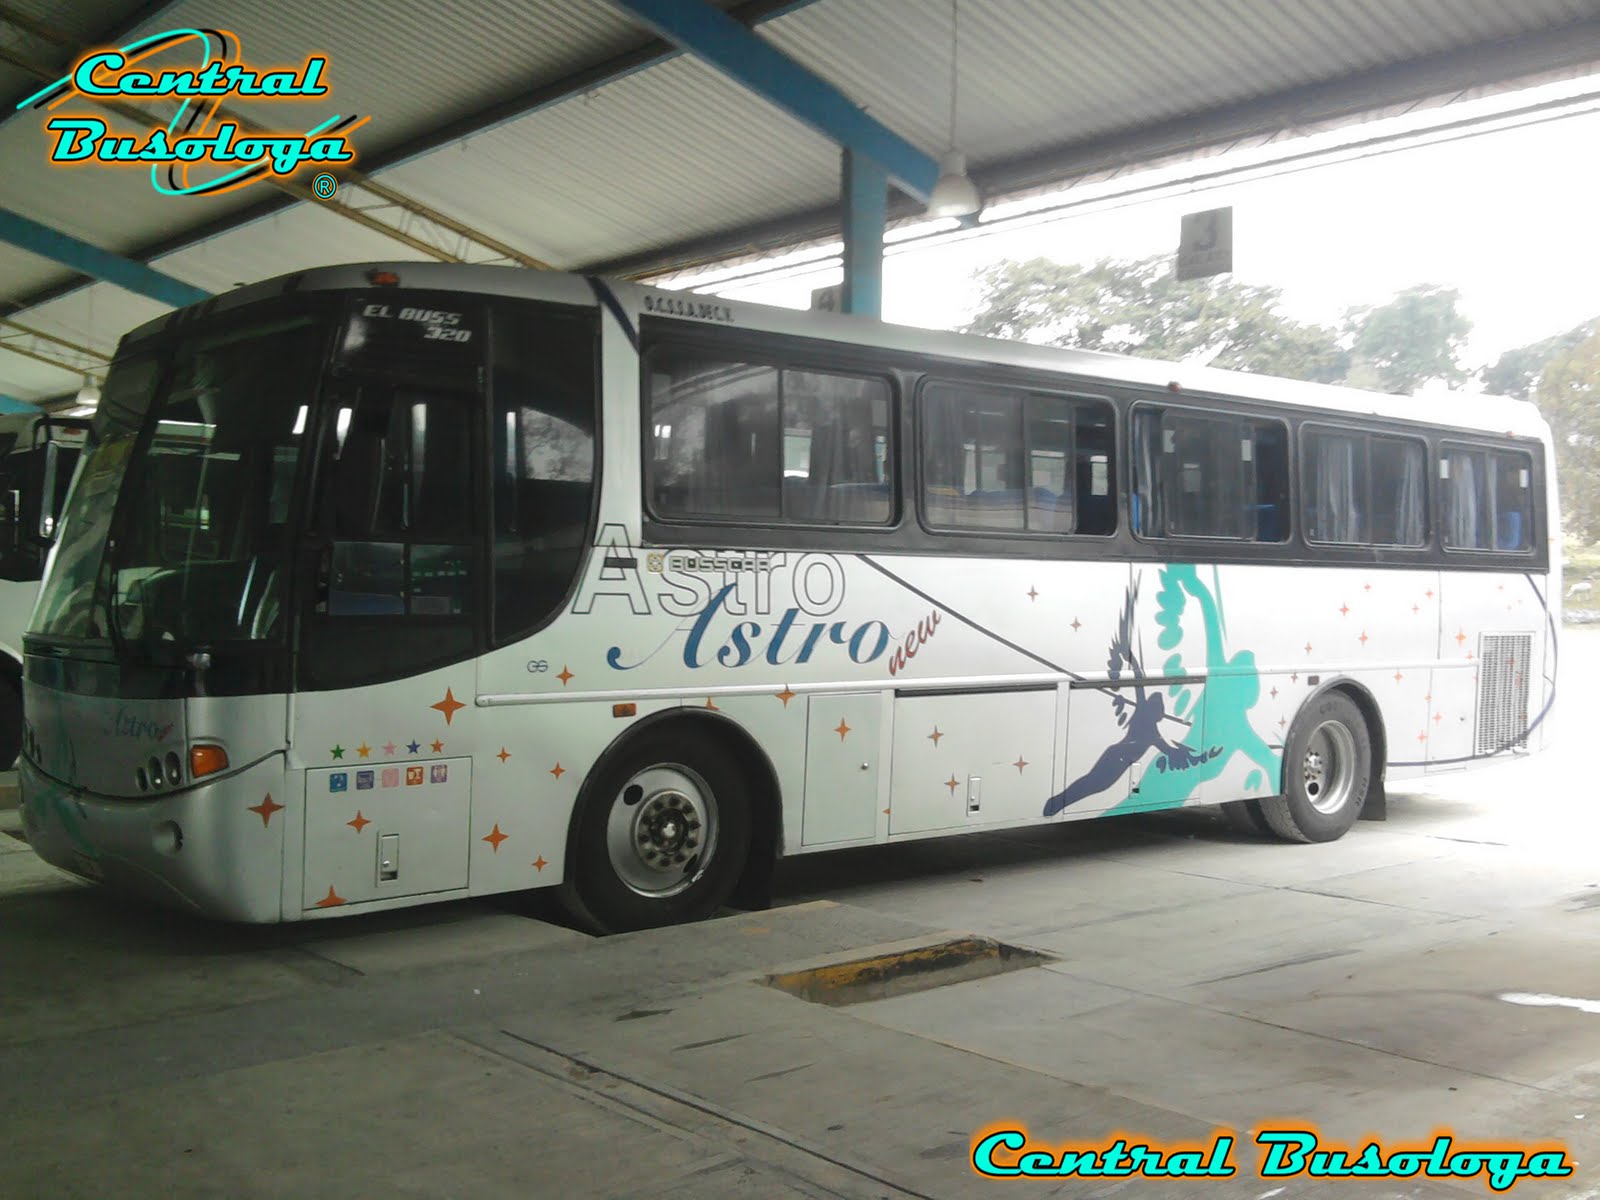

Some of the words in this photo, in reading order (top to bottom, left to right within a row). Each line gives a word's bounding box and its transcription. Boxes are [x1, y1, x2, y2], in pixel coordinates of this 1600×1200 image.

[363, 304, 392, 319] EL
[398, 306, 463, 327] BUSS
[423, 325, 473, 344] 320
[570, 523, 846, 617] Astro
[668, 554, 772, 574] BUSSCAR
[606, 582, 894, 671] Astro
[888, 609, 941, 677] new
